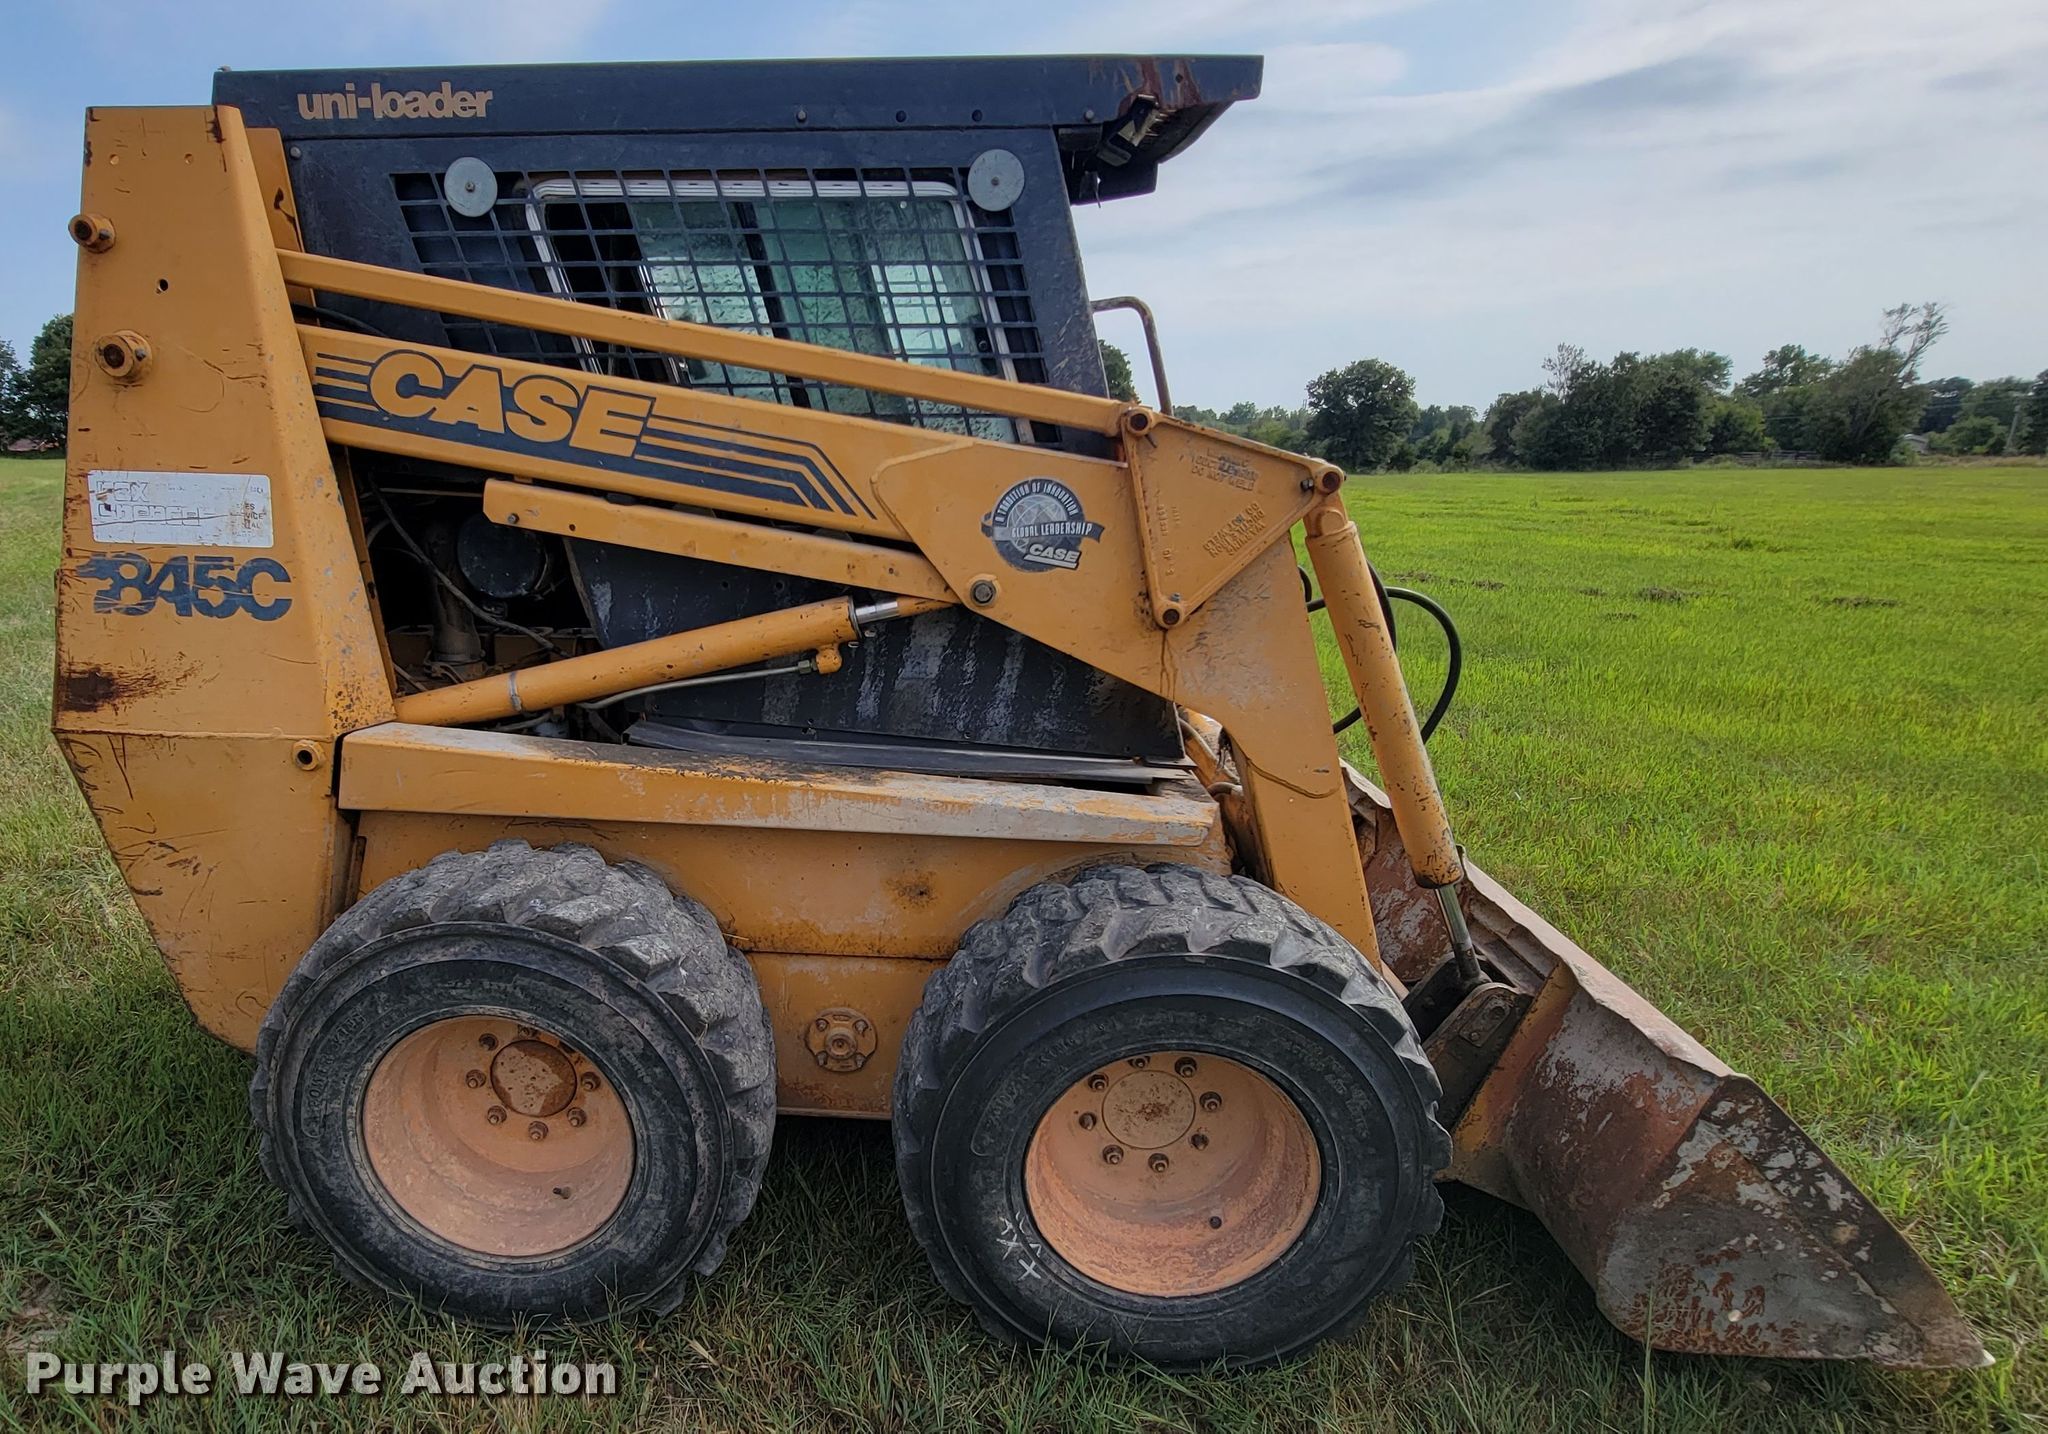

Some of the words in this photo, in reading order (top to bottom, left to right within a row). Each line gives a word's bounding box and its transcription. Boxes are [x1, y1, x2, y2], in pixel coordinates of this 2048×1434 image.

[297, 81, 493, 120] uni-loader
[369, 350, 656, 458] CASE
[997, 484, 1030, 517] TRADITION
[1031, 482, 1041, 493] OF
[1043, 483, 1079, 516] INNOVATION
[1011, 526, 1039, 538] GLOBAL
[1041, 522, 1093, 536] LEADERSHIP
[1029, 543, 1081, 563] CASE
